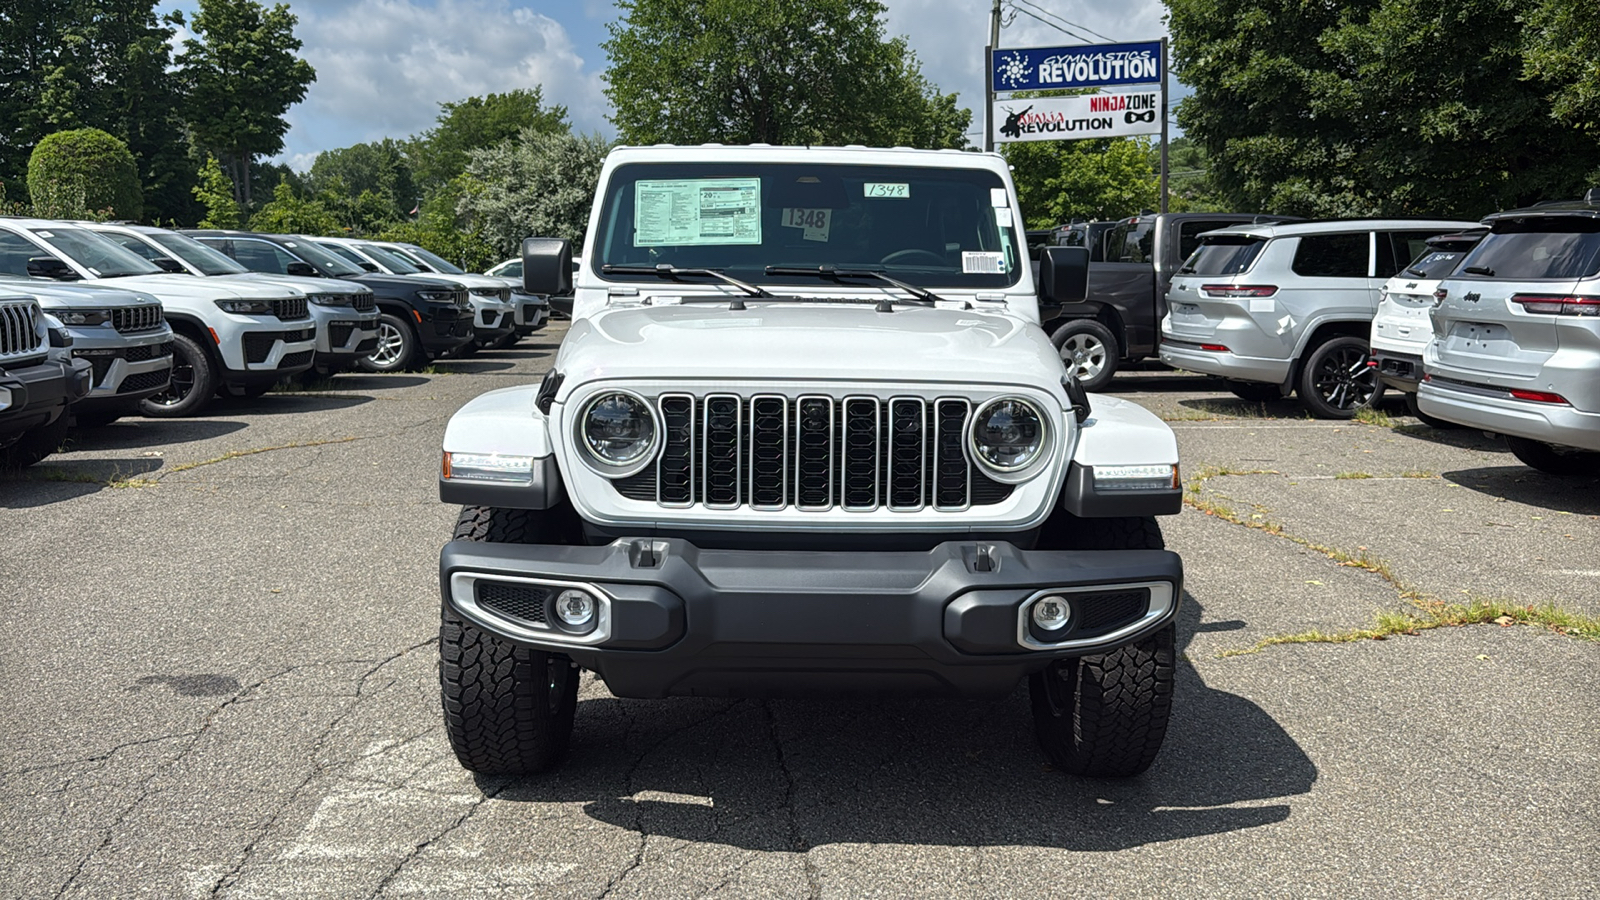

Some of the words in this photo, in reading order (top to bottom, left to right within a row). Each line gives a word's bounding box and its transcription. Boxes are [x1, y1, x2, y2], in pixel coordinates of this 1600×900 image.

[1043, 50, 1152, 65] GYMNASTICS
[1039, 57, 1157, 83] REVOLUTION
[1090, 94, 1156, 112] NINJAZONE
[1019, 118, 1112, 133] REVOLUTION
[869, 184, 906, 197] 1348
[788, 207, 827, 230] 1348
